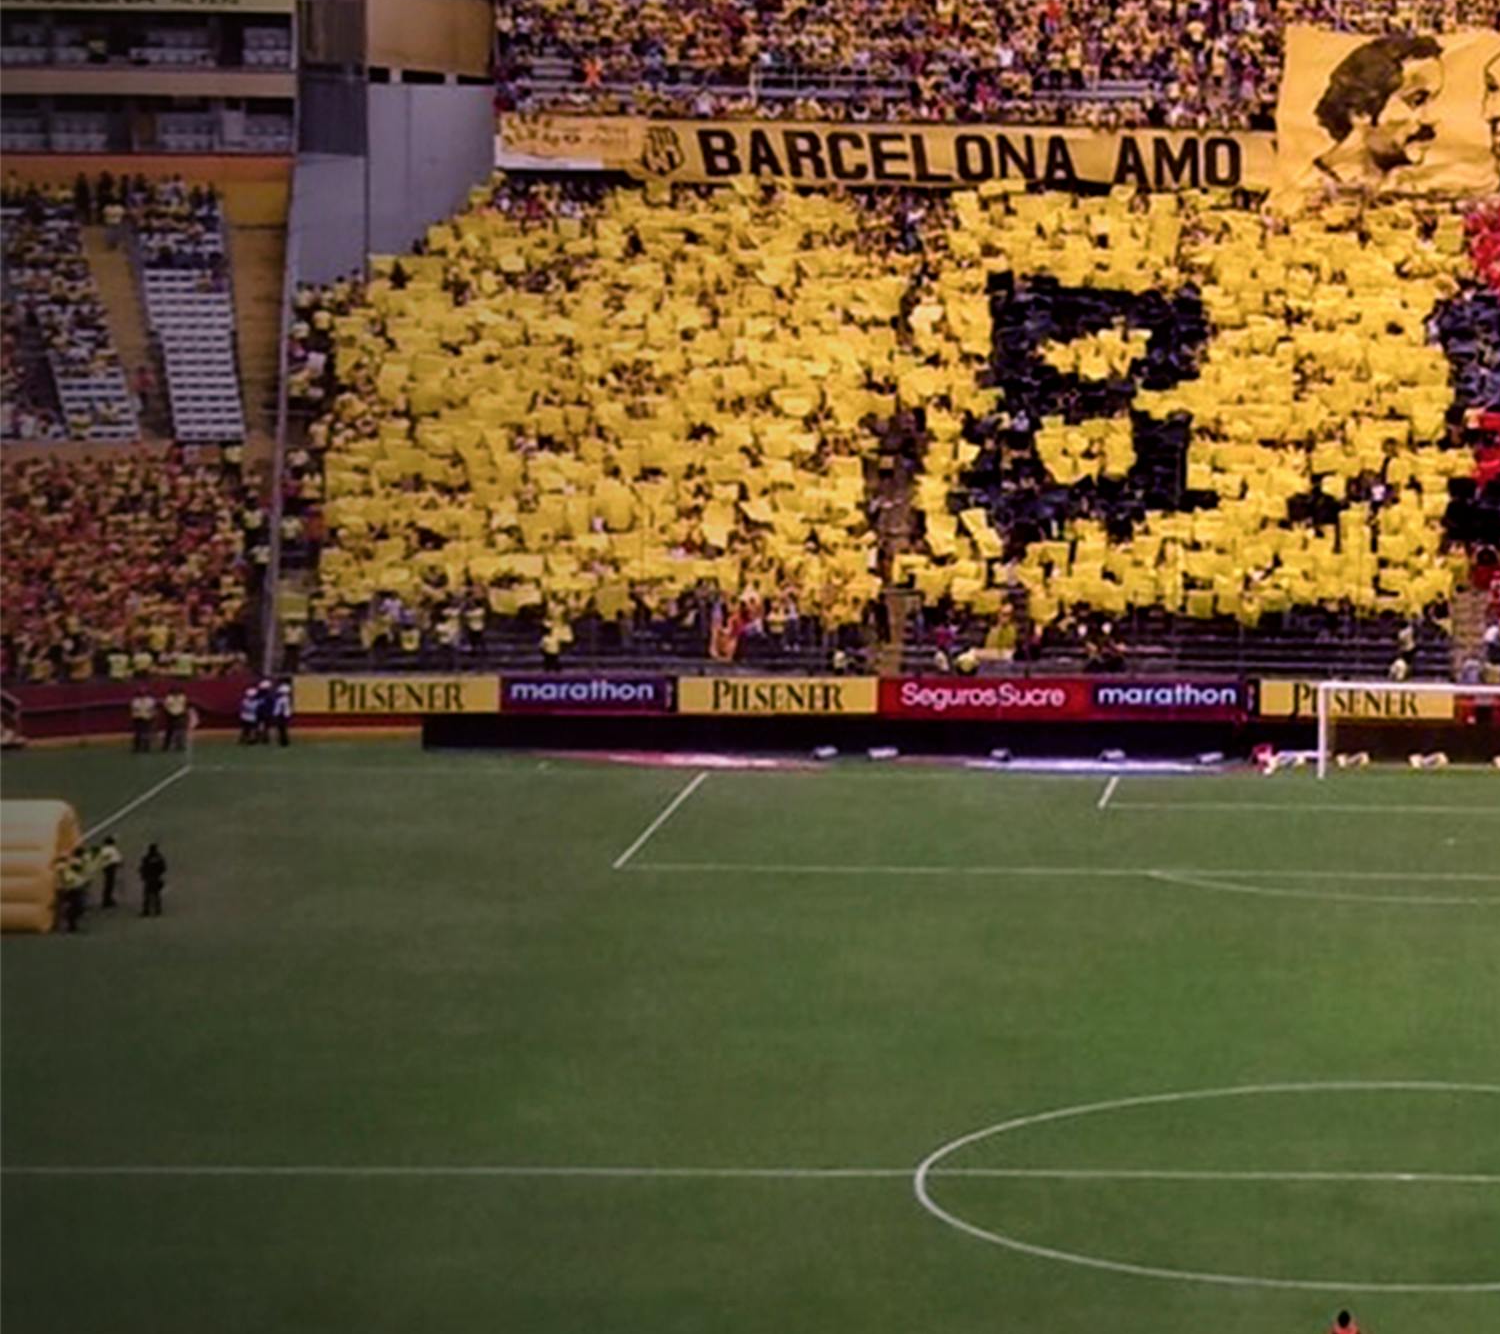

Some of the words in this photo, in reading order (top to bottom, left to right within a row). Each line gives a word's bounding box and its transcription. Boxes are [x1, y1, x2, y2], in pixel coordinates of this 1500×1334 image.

[699, 130, 1078, 181] BARCELONA
[1114, 137, 1241, 189] AMO
[328, 678, 464, 710] PILSENER
[510, 682, 654, 701] marathon
[712, 679, 844, 711] PILSENER
[901, 682, 997, 710] Seguros
[1000, 683, 1065, 706] Sucre
[1098, 685, 1236, 706] marathon
[1292, 682, 1419, 716] PISENER
